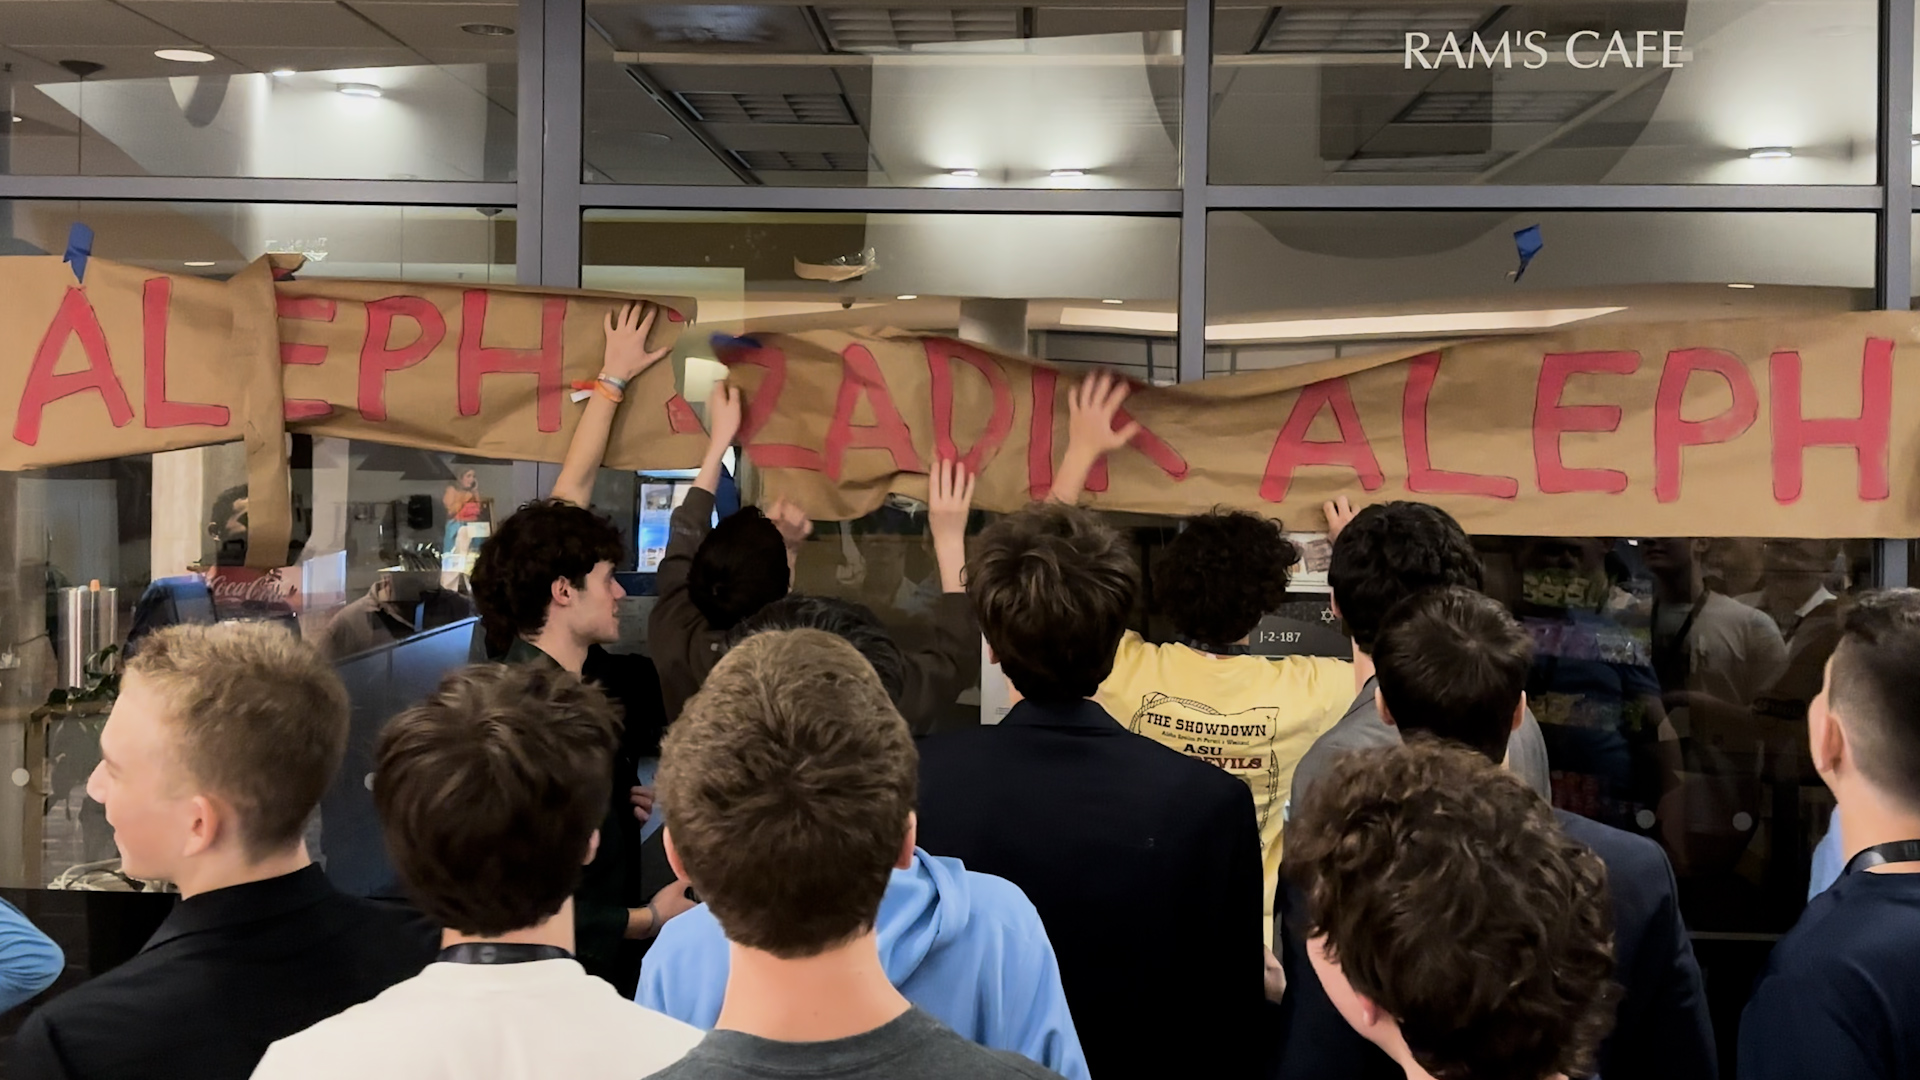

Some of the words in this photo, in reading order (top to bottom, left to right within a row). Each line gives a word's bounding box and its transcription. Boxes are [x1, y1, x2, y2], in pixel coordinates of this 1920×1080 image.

[1404, 30, 1548, 70] RAM'S
[1565, 30, 1684, 69] CAFE
[1259, 336, 1894, 504] ALEPH
[1260, 631, 1301, 643] J-2-187
[1146, 712, 1172, 728] THE
[1175, 719, 1267, 737] SHOWDOWN
[1183, 743, 1223, 756] ASU
